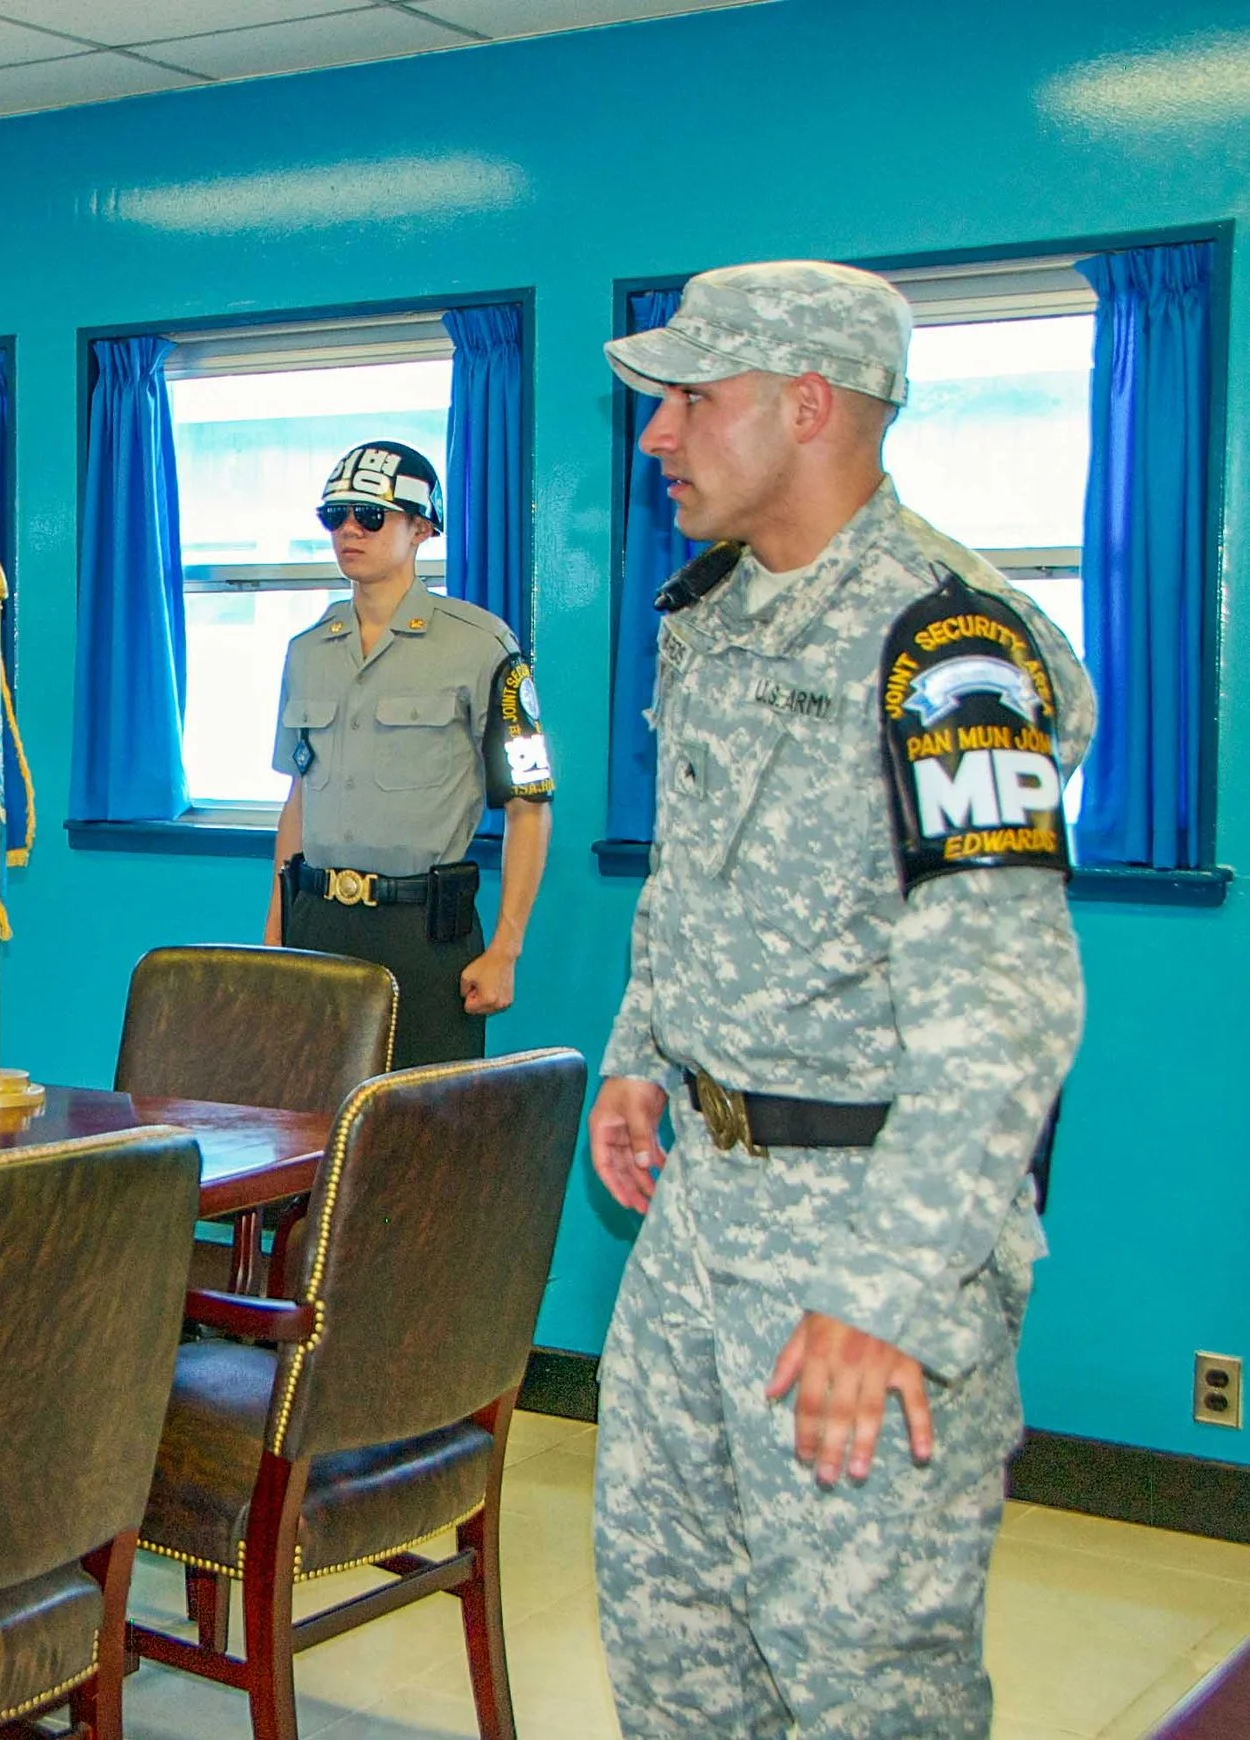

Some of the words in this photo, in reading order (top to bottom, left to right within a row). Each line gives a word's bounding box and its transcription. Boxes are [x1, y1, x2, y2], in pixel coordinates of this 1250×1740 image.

[885, 651, 919, 720] JOINT
[914, 613, 1028, 653] SECURITY
[501, 686, 518, 722] JOINT
[907, 727, 953, 761] PAN
[958, 725, 1012, 750] MUN
[913, 749, 1061, 839] MP
[943, 827, 1057, 861] EDWARDS
